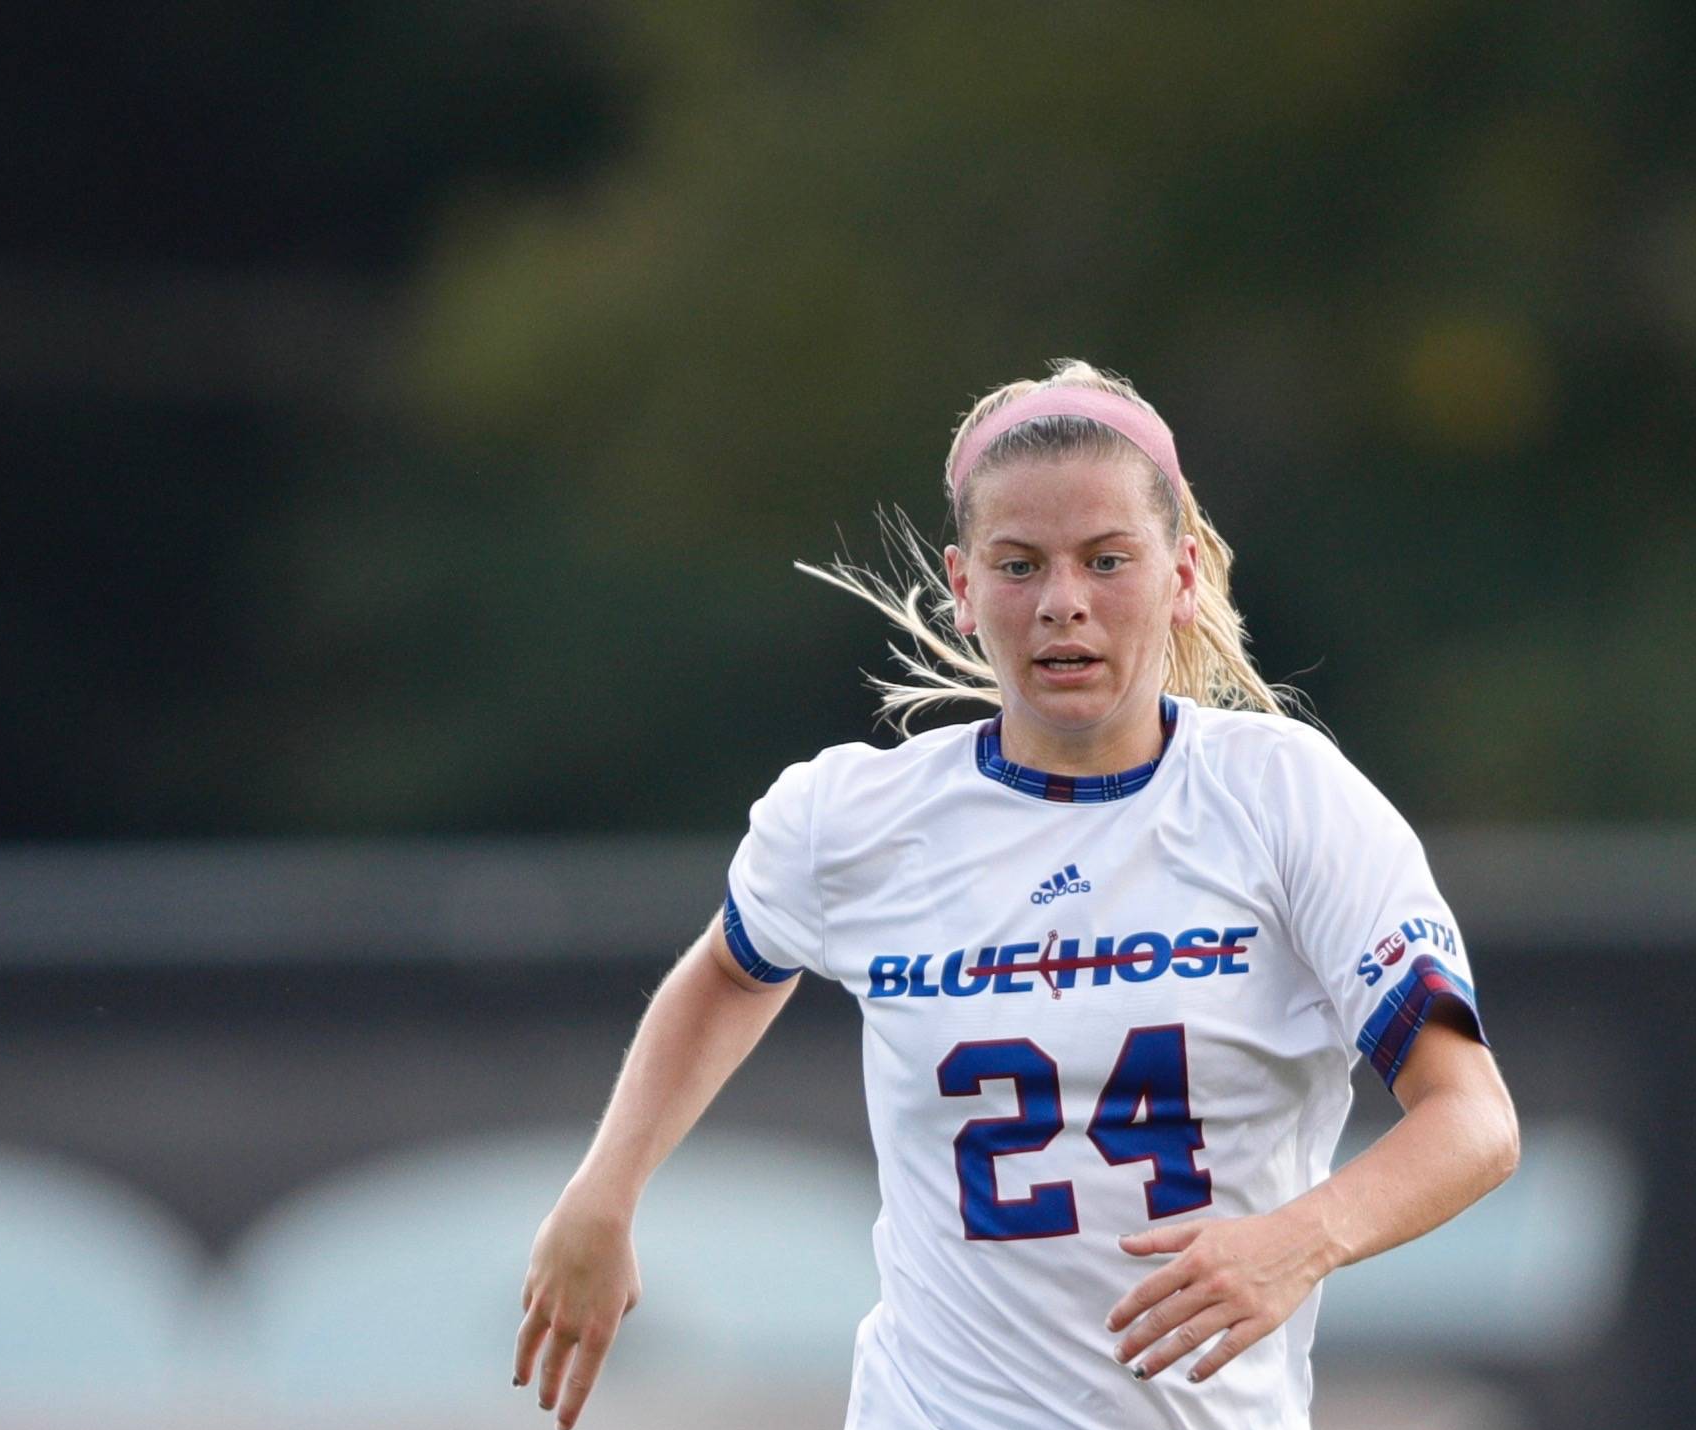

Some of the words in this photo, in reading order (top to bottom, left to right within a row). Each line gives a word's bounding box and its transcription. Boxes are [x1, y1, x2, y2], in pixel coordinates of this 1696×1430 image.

[1030, 880, 1091, 904] addas
[867, 941, 1040, 998] BLUE
[1055, 926, 1259, 989] HOSE
[937, 1023, 1212, 1241] 24
